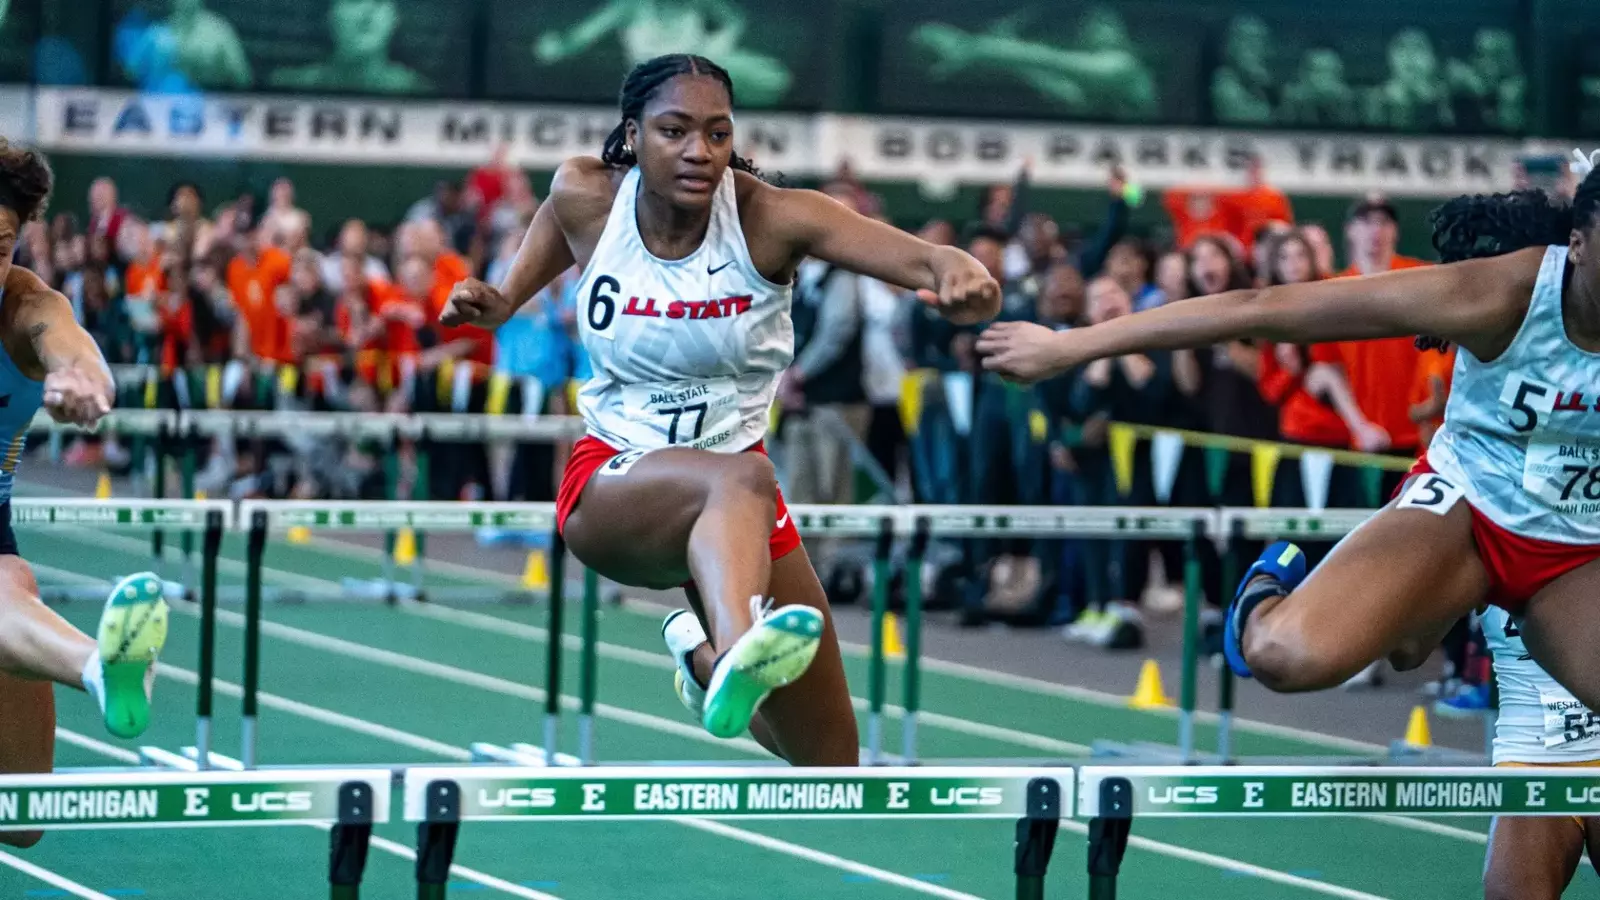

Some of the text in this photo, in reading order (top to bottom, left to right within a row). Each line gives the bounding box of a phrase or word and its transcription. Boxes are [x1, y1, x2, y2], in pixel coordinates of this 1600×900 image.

[64, 100, 400, 143] EASTERN
[443, 113, 788, 154] MICHN
[1298, 140, 1492, 177] TRACK
[588, 274, 621, 331] 6
[621, 294, 753, 319] LL STATE
[650, 384, 710, 404] BALL STATE
[1509, 380, 1547, 432] 5
[659, 401, 708, 444] 77
[1559, 445, 1587, 459] BALL
[1411, 477, 1455, 505] 5
[1560, 464, 1600, 500] 78
[28, 789, 157, 820] MICHIGAN
[183, 788, 209, 816] E
[232, 792, 312, 812] UCS
[479, 782, 1003, 811] UCS E EASTERN MICHIGAN E UCS
[1148, 786, 1219, 804] UCS
[1243, 782, 1264, 807] E
[1291, 781, 1386, 807] EASTERN
[1396, 781, 1503, 807] MICHIGAN
[1526, 781, 1545, 806] E
